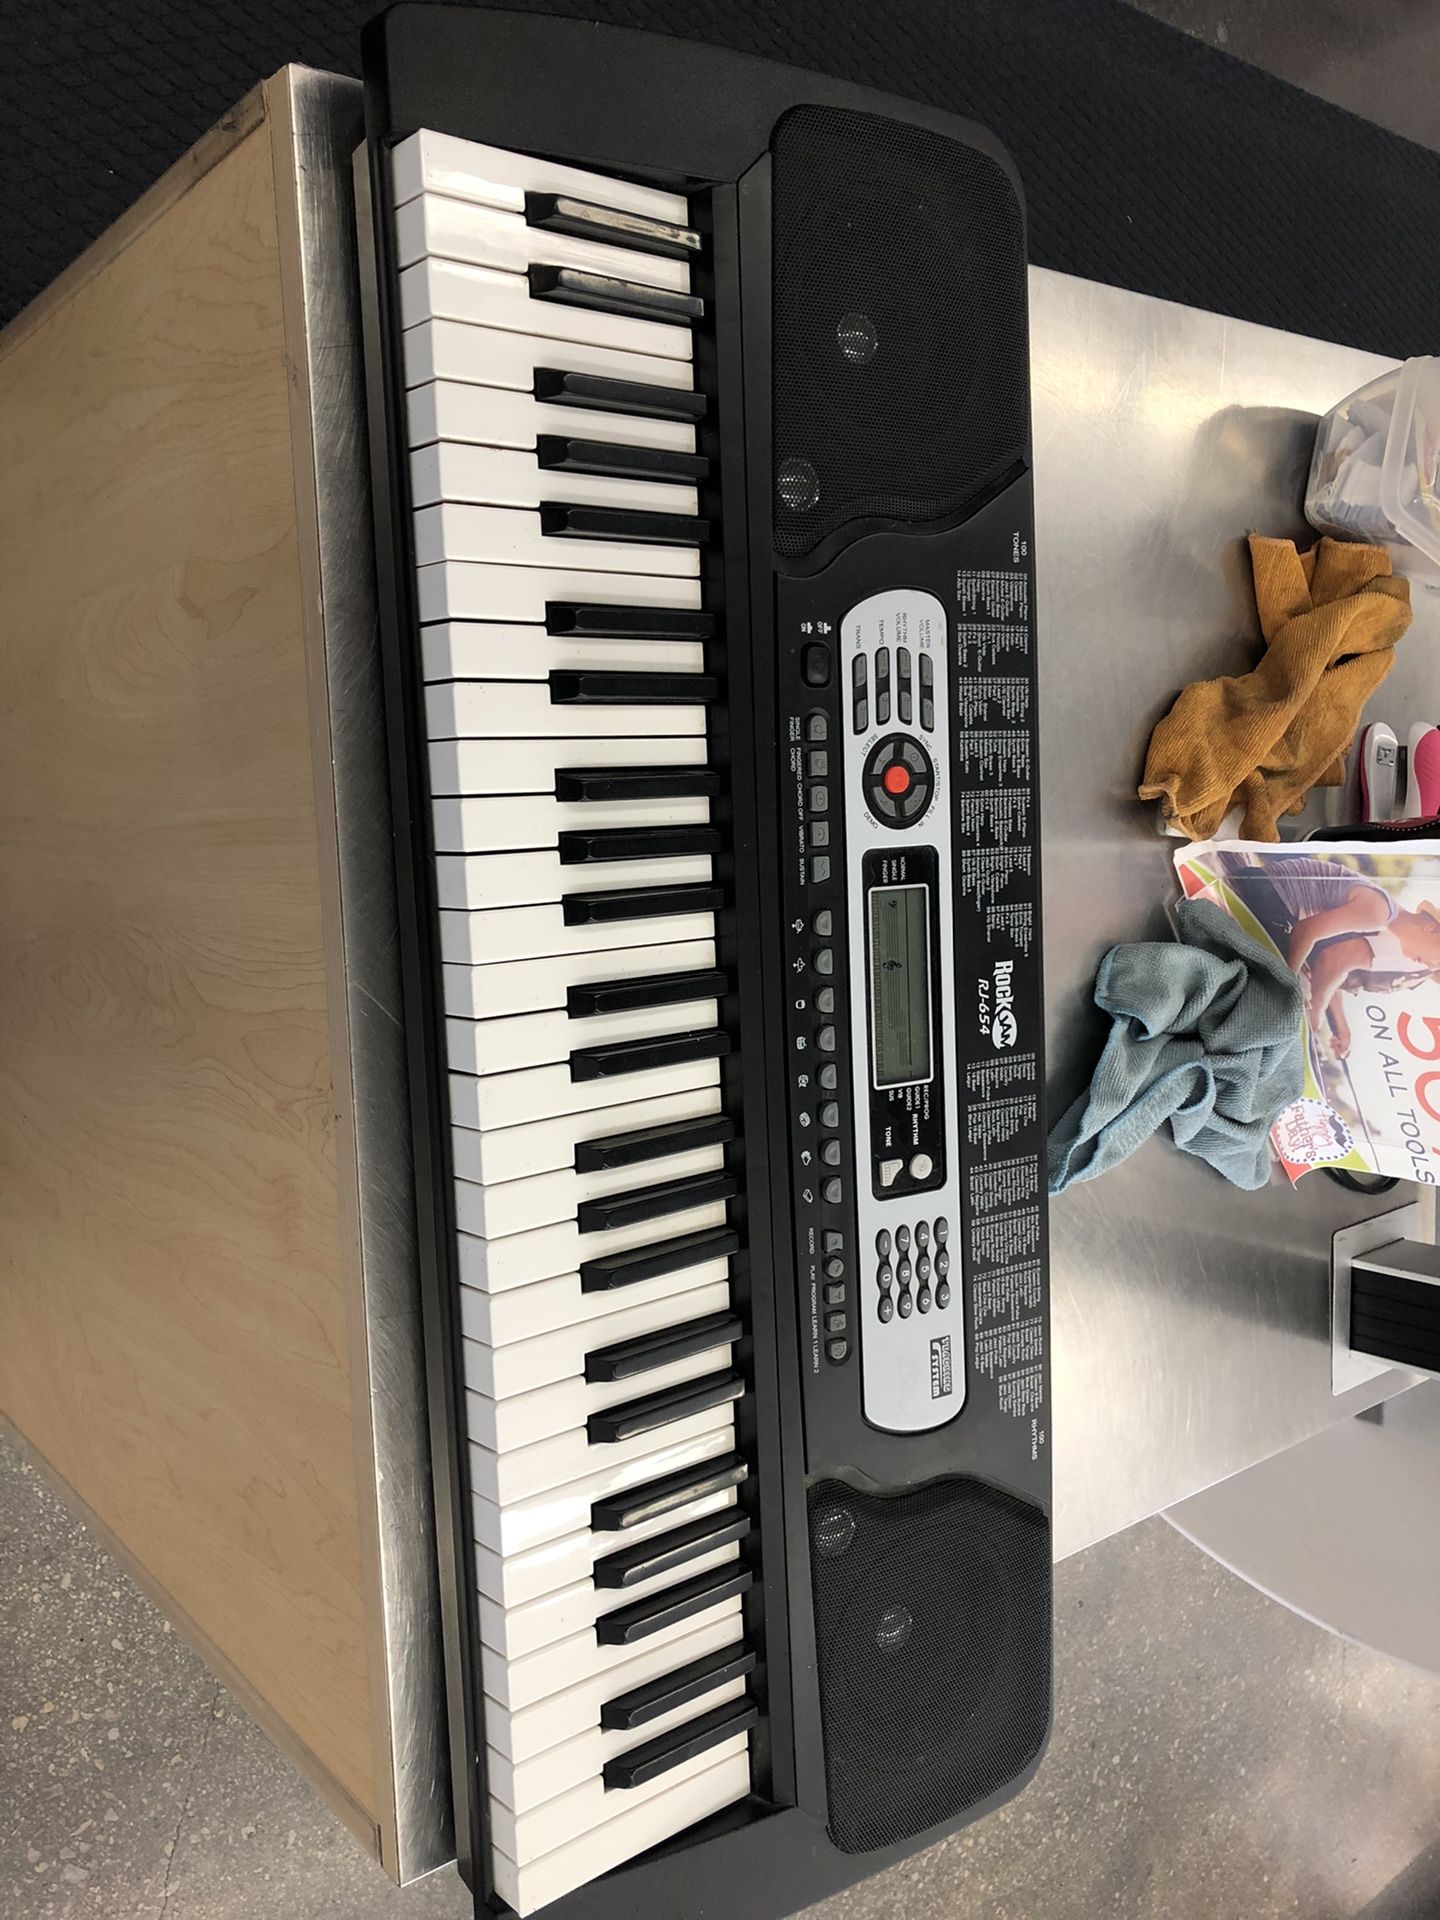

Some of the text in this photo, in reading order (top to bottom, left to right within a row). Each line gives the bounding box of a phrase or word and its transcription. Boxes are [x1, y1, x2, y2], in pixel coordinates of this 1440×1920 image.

[801, 623, 806, 632] ON
[860, 733, 878, 756] SELECT
[919, 734, 932, 751] SYNC
[933, 758, 941, 801] START/STOP
[864, 812, 878, 829] DEMO
[925, 805, 935, 819] FILL
[978, 978, 990, 1035] RJ-654
[1366, 1005, 1392, 1040] ON
[1378, 1052, 1408, 1098] ALL
[1291, 1105, 1318, 1158] Father's
[1397, 1109, 1435, 1184] TOOLS
[921, 1265, 929, 1273] 5
[903, 1302, 911, 1310] 9
[932, 1354, 940, 1397] SYSTEM
